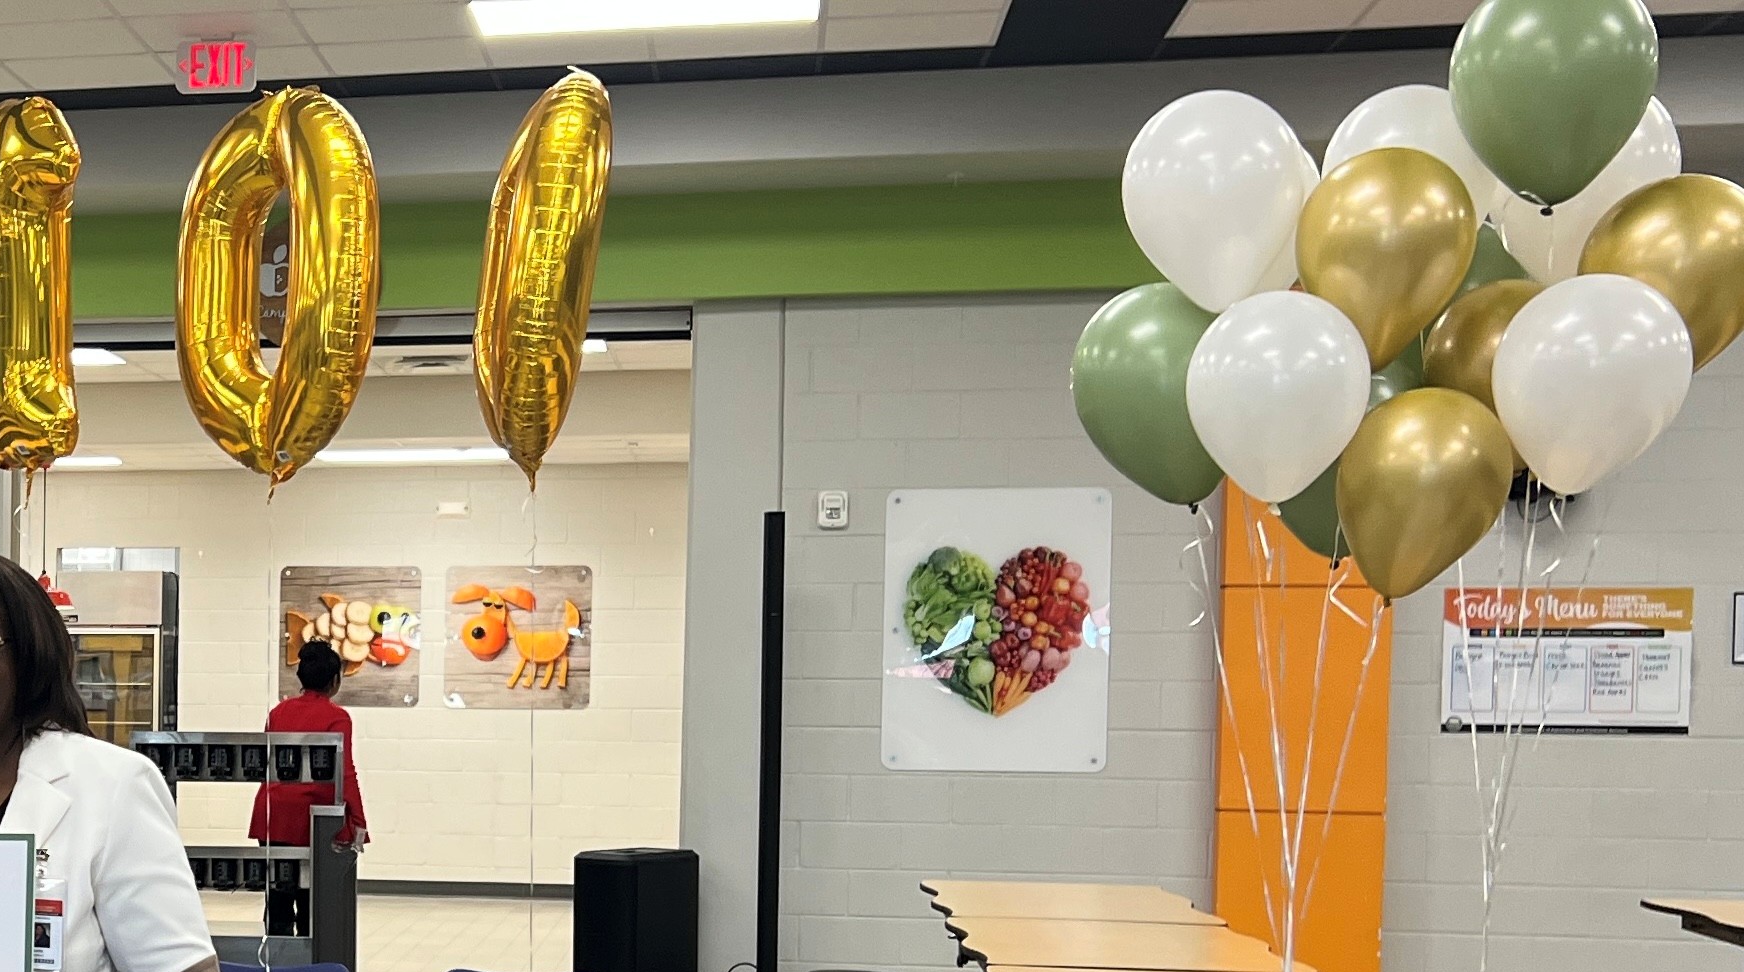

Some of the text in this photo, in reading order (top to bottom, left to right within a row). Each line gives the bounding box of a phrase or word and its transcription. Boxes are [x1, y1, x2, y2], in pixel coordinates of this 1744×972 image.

[189, 42, 248, 89] EXIT
[1453, 594, 1599, 625] Today's Menu
